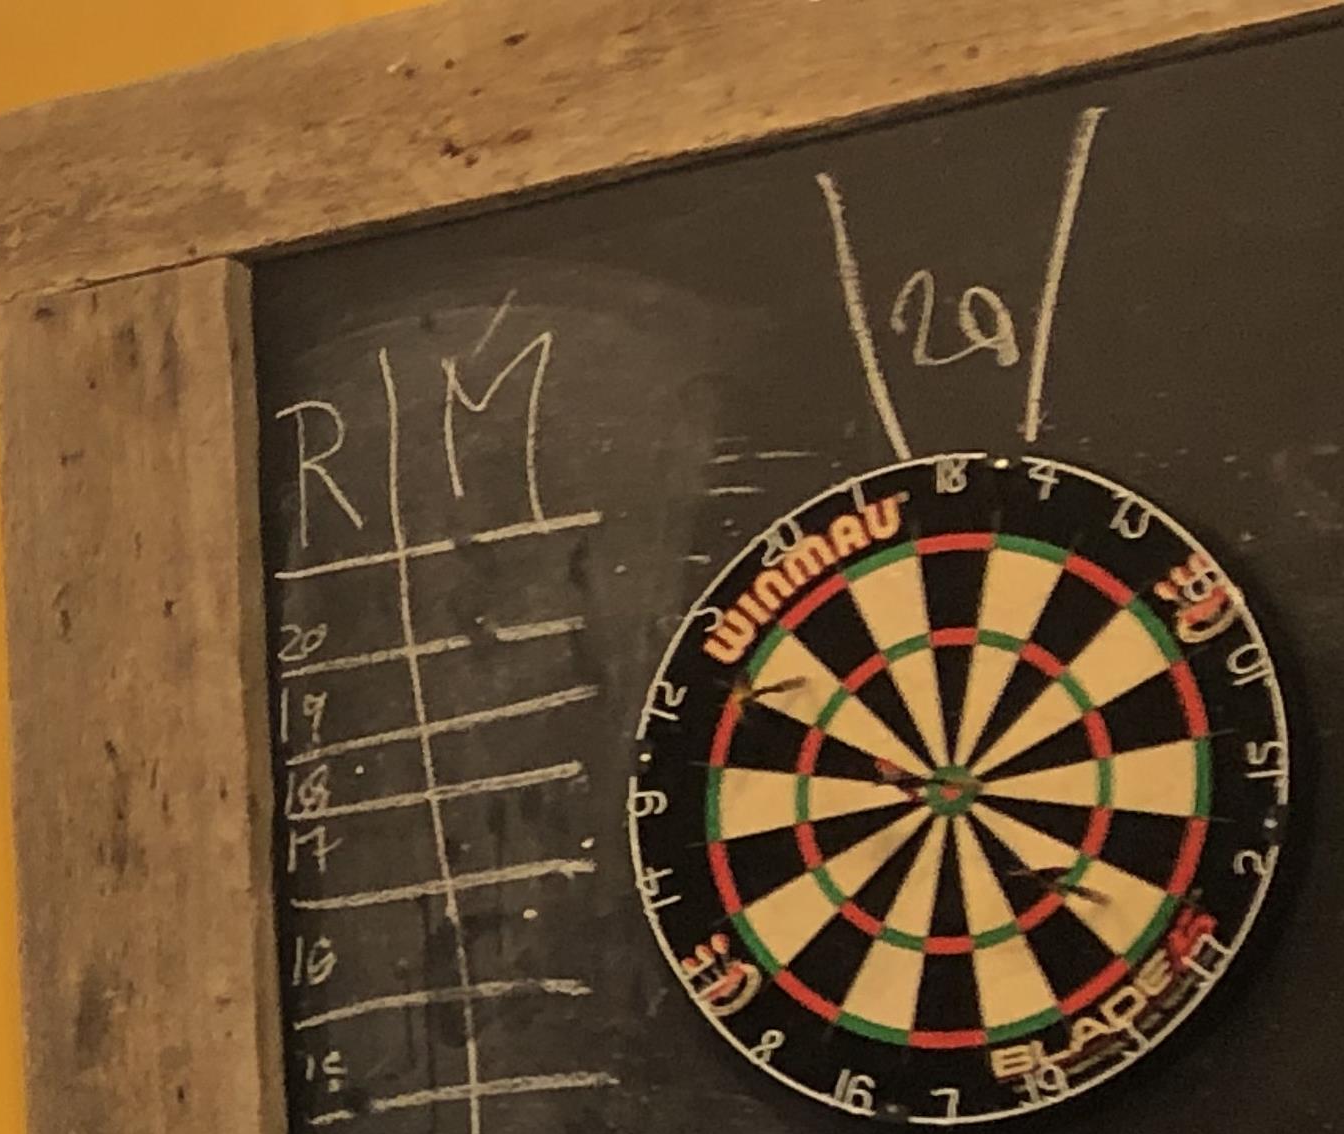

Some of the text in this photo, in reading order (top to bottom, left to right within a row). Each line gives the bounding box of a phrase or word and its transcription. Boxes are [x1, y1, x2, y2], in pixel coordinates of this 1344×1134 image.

[275, 330, 554, 549] R M
[1028, 462, 1059, 500] 4
[703, 496, 902, 664] WINMAU
[277, 623, 327, 662] 20
[1226, 642, 1273, 687] 10
[280, 686, 328, 745] 19
[1243, 741, 1286, 780] 15
[287, 825, 343, 875] 17
[989, 948, 1173, 1084] BLADE
[749, 1028, 786, 1064] 8
[833, 1068, 876, 1116] 16
[929, 1087, 959, 1121] 7
